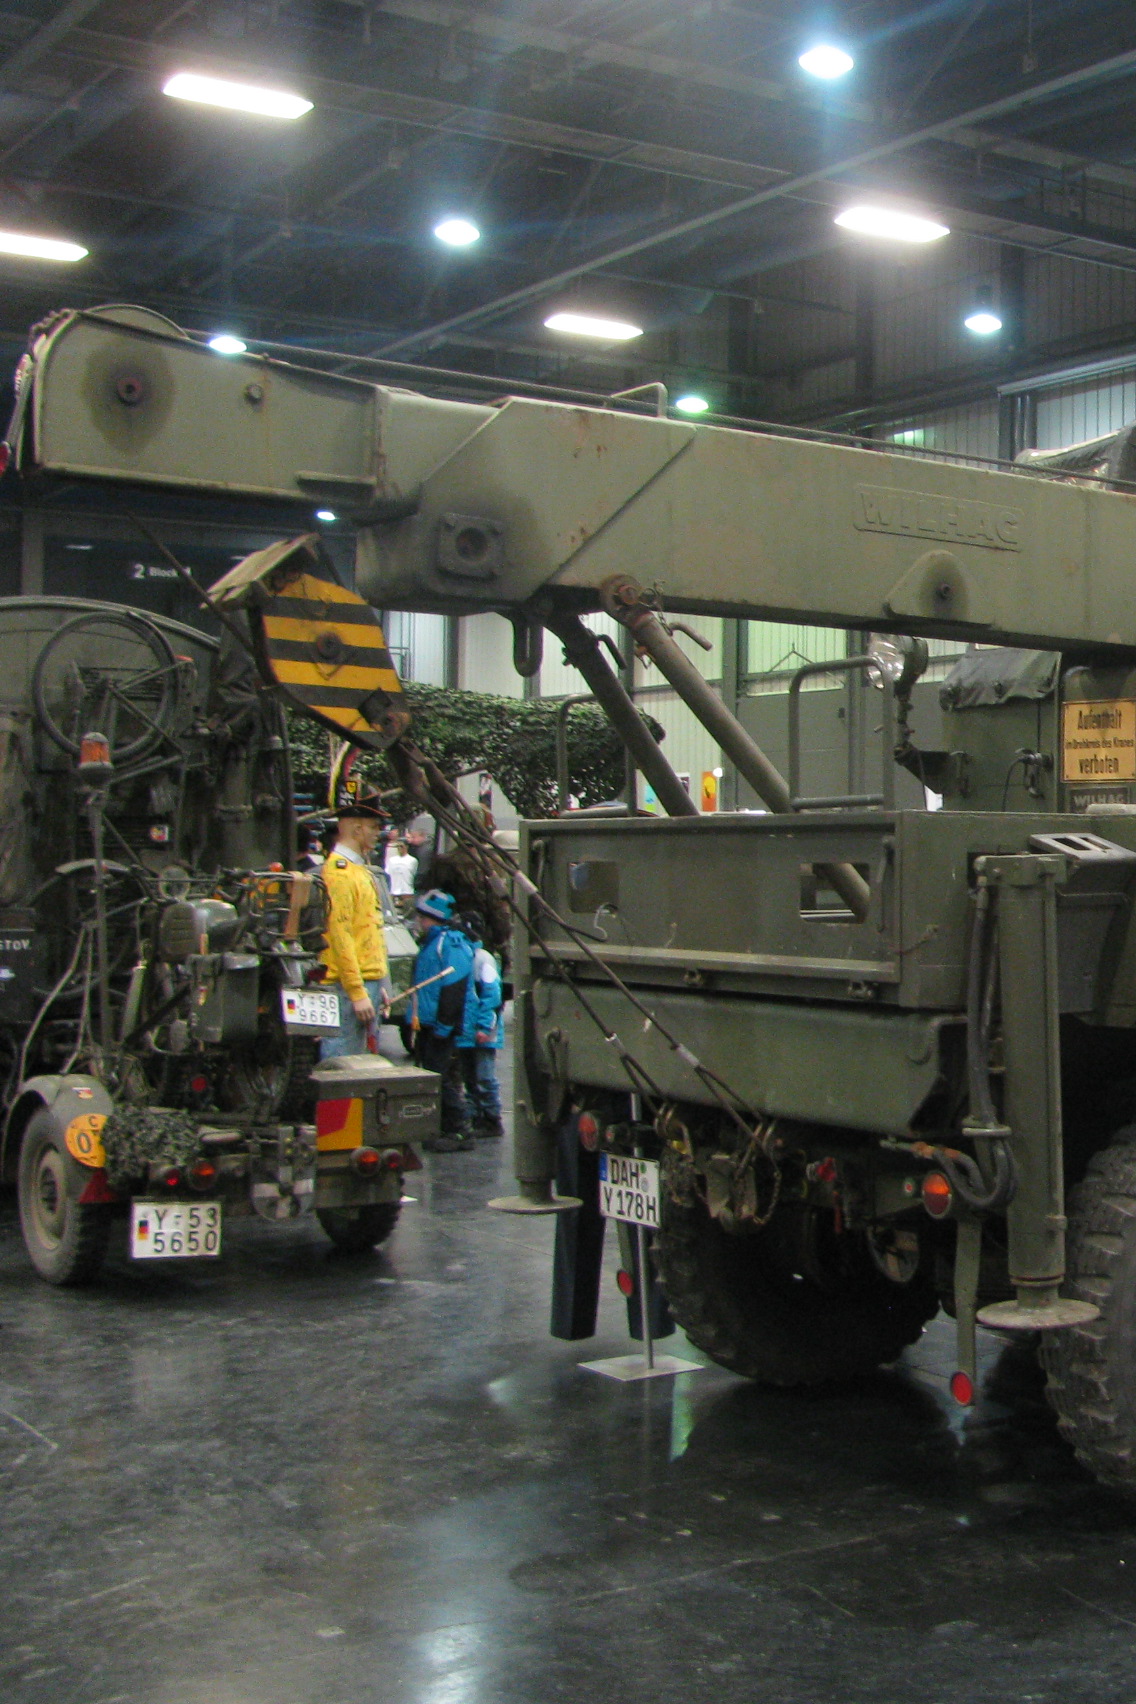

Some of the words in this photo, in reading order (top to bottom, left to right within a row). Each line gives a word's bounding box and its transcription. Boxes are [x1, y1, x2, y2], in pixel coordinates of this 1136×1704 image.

[134, 563, 145, 578] 2
[1078, 708, 1122, 730] Aufenthalt
[1102, 738, 1112, 748] des
[1079, 754, 1119, 774] verboten
[299, 1008, 337, 1024] 9667
[610, 1158, 640, 1189] DAH
[604, 1186, 613, 1212] Y
[616, 1190, 657, 1222] 178H
[153, 1230, 218, 1253] 5650
